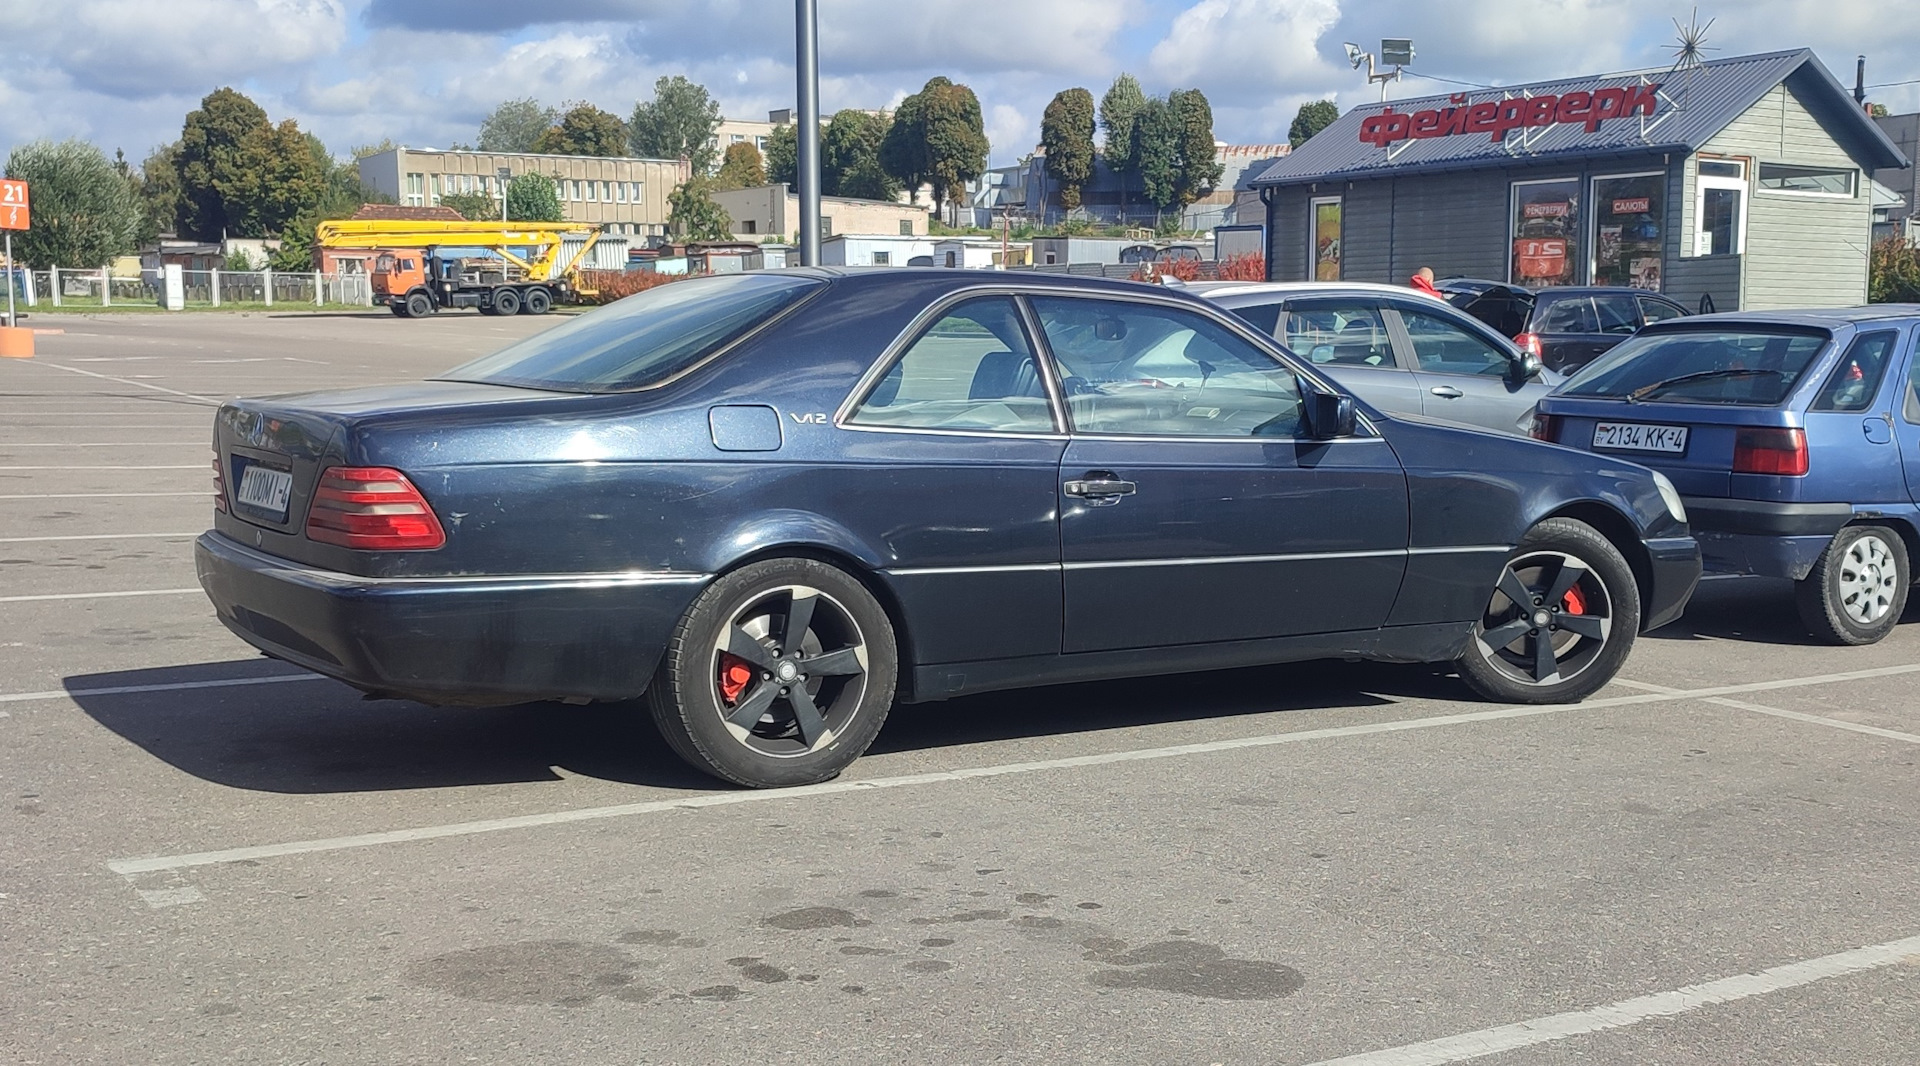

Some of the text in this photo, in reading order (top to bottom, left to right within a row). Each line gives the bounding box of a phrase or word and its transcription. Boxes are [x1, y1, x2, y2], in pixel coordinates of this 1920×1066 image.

[4, 184, 23, 202] 21
[1614, 201, 1648, 211] САЛЮТЫ
[790, 412, 827, 424] V12
[1606, 425, 1640, 446] 2134
